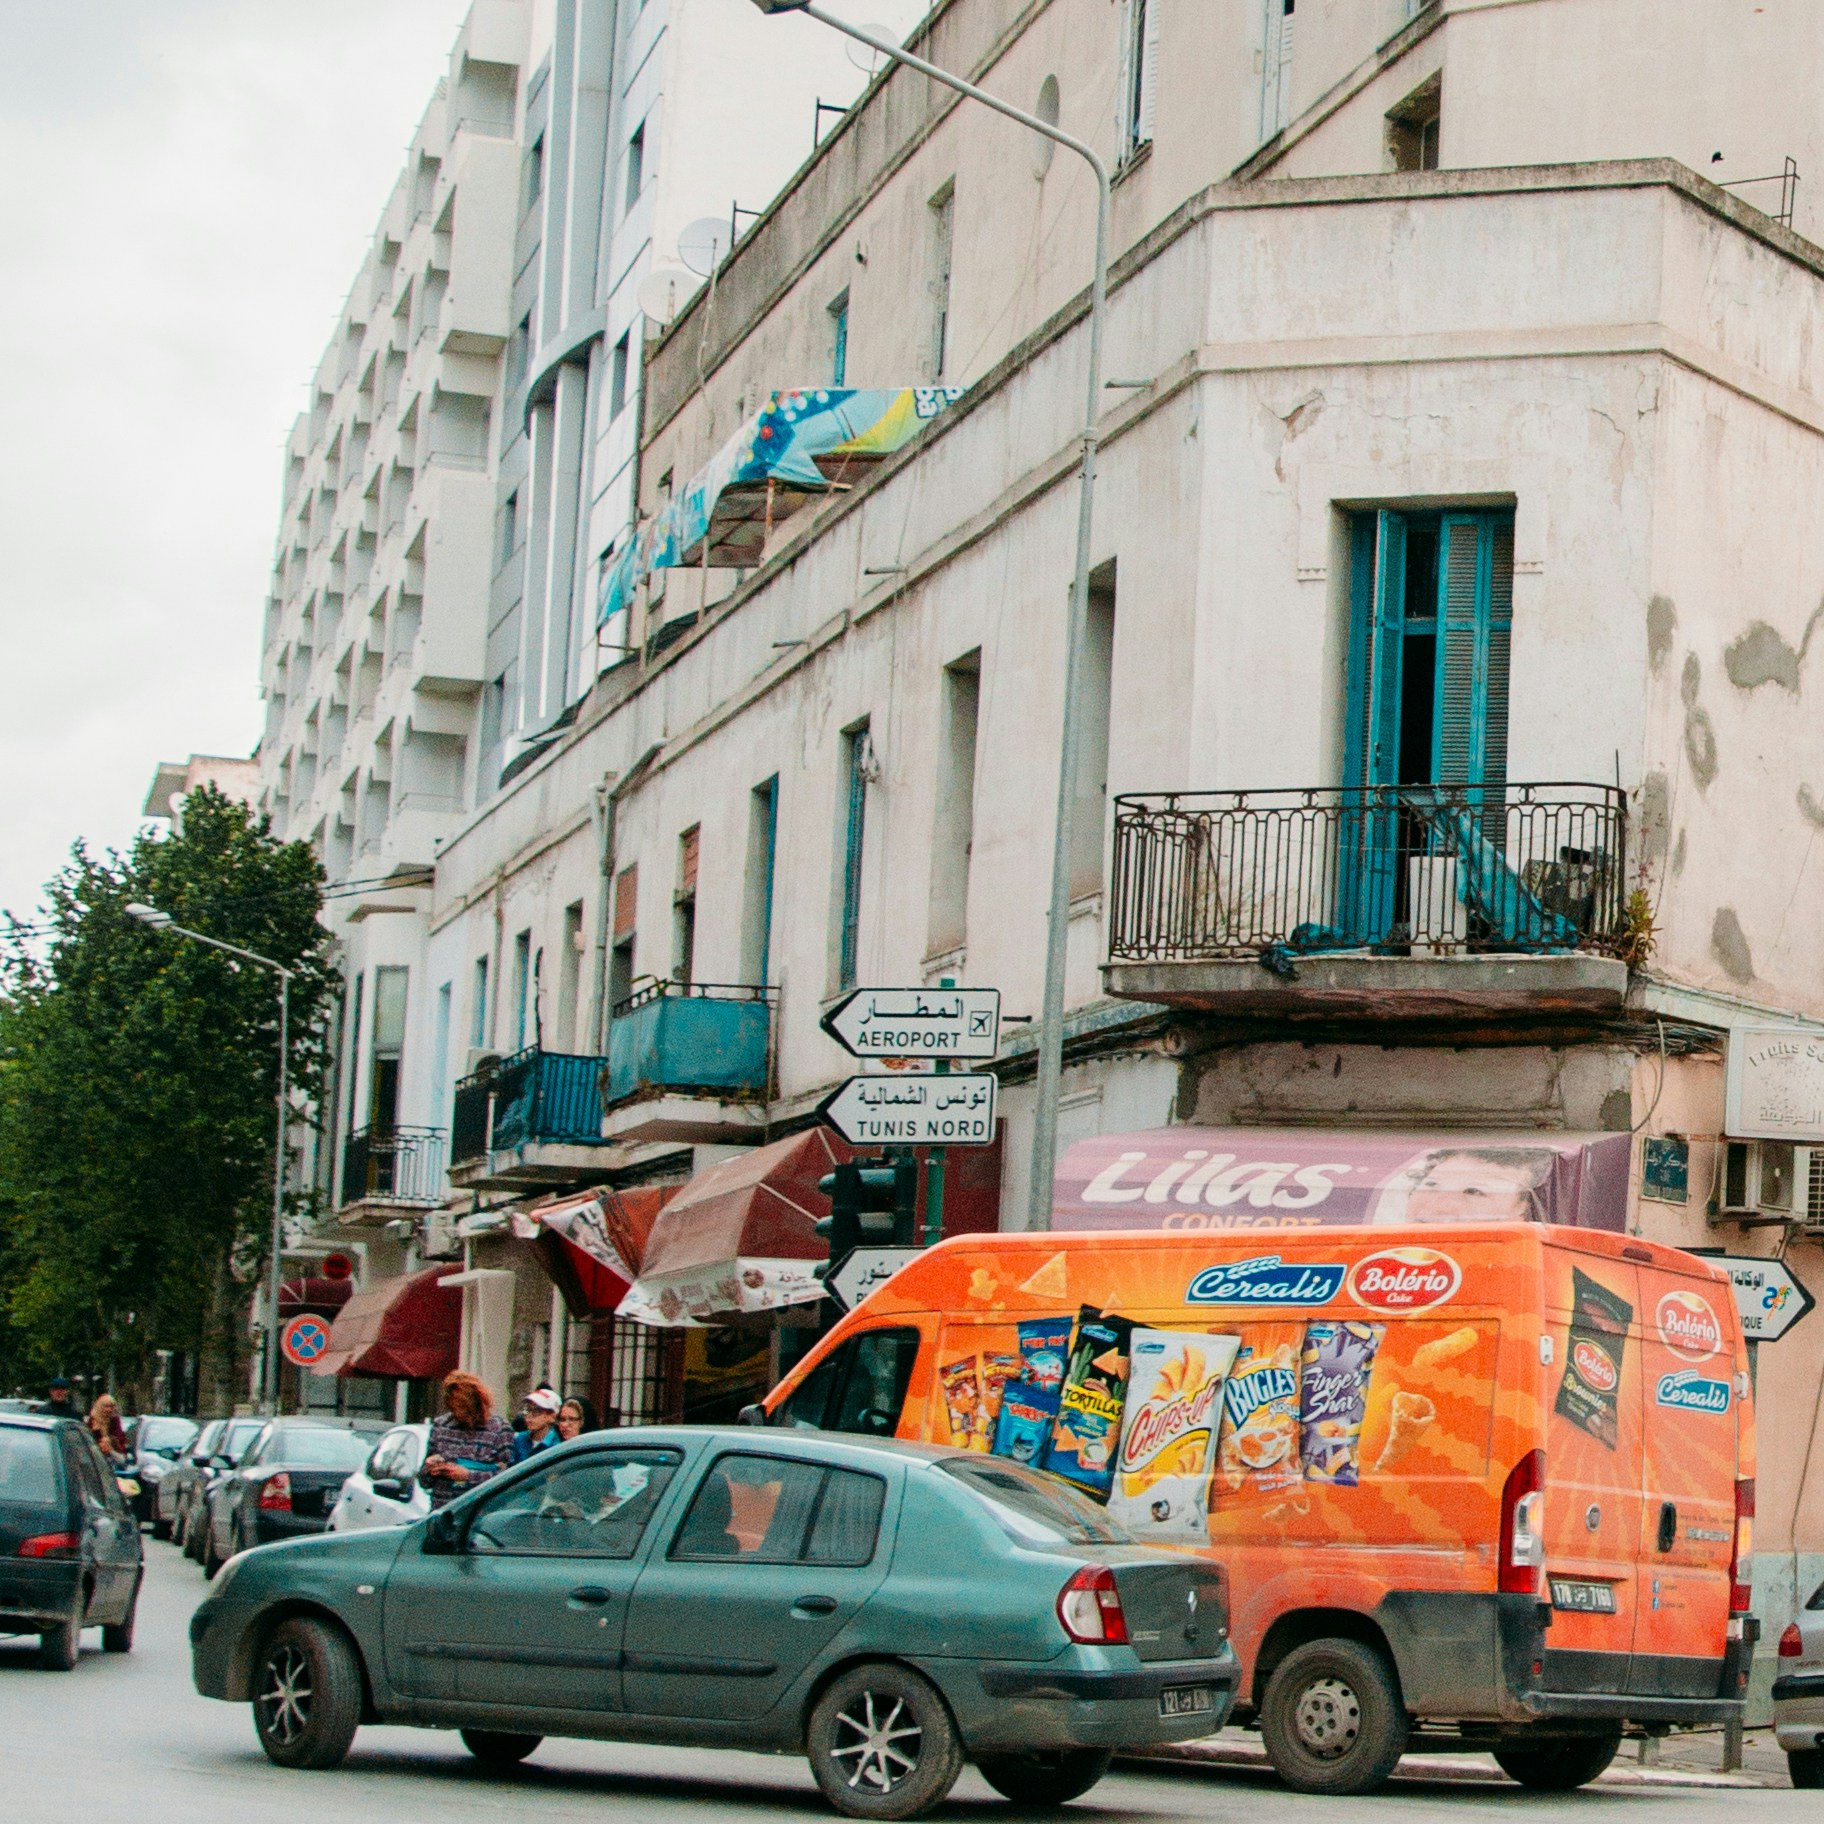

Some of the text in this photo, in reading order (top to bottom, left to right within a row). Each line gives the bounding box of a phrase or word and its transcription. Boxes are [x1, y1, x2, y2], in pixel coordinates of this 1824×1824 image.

[858, 996, 964, 1024] المطار
[857, 1031, 962, 1048] AEROPORT
[857, 1083, 988, 1112] تونس الشمالية
[857, 1120, 985, 1137] TUNIS NORD
[1081, 1149, 1353, 1209] Lilas
[1191, 1268, 1333, 1299] Cerealis
[1359, 1267, 1449, 1292] Bolério
[1385, 1292, 1413, 1304] Cake
[1065, 1388, 1122, 1418] TORTILLAS
[1225, 1368, 1297, 1431] BUGLES
[1658, 1376, 1727, 1409] Cerealis
